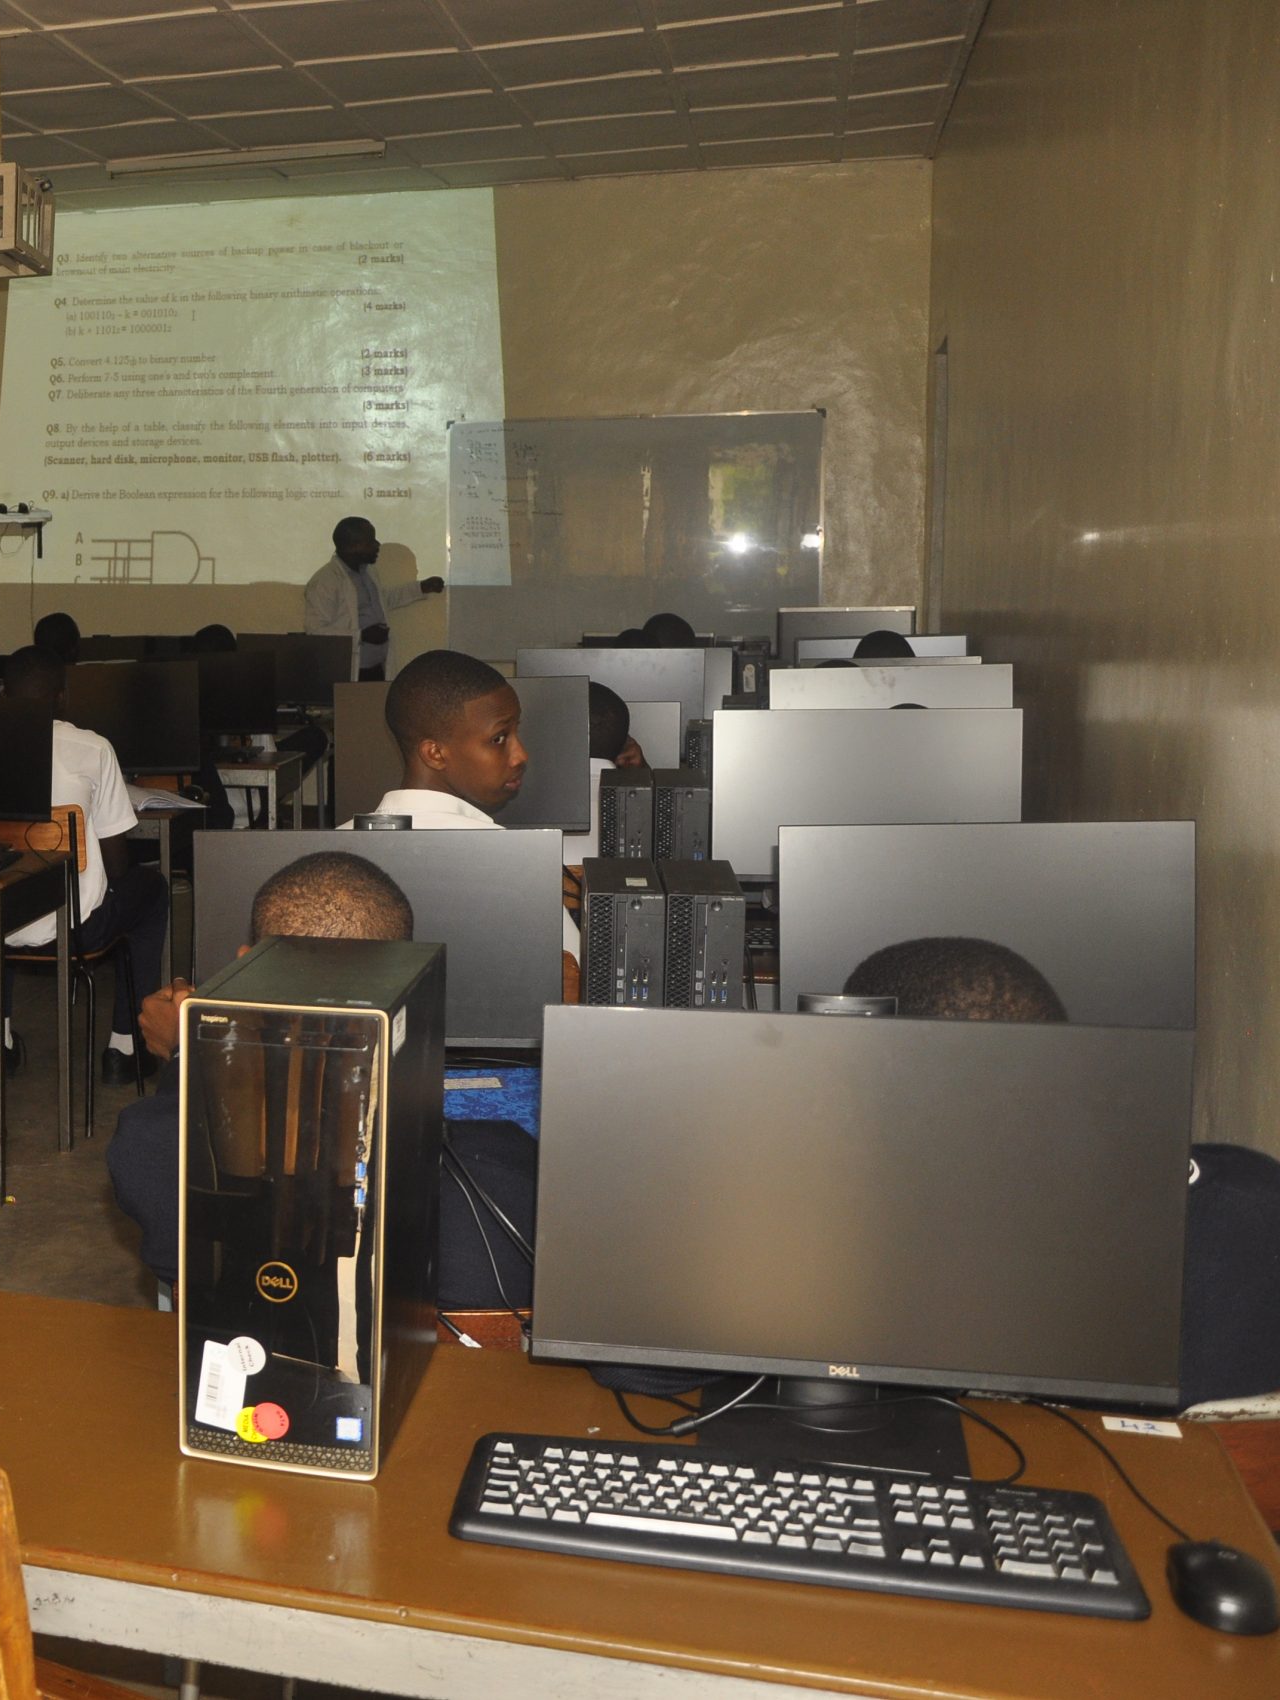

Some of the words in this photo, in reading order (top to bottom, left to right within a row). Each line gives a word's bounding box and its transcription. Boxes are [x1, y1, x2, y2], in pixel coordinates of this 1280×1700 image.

[132, 250, 177, 261] alternative
[181, 248, 215, 258] sources
[218, 246, 229, 256] of
[231, 245, 263, 257] backup
[268, 245, 295, 257] power
[299, 245, 308, 254] in
[312, 244, 333, 253] case
[336, 241, 345, 252] of
[349, 240, 389, 251] blackout
[393, 242, 405, 250] or
[99, 264, 108, 275] of
[72, 296, 118, 307] Determine
[119, 294, 134, 304] the
[161, 292, 170, 303] of
[171, 292, 179, 303] k
[180, 293, 189, 303] in
[191, 290, 206, 302] the
[207, 288, 248, 302] following
[250, 288, 280, 301] binary
[281, 287, 328, 299] arithmetic
[68, 356, 103, 368] Convert
[138, 354, 148, 365] to
[150, 354, 178, 366] binary
[68, 371, 102, 384] Perform
[122, 371, 146, 384] using
[173, 369, 191, 381] and
[67, 387, 112, 400] Deliberate
[114, 390, 131, 400] any
[132, 387, 156, 399] three
[157, 384, 225, 398] characteristics
[226, 384, 237, 395] of
[238, 383, 253, 395] the
[255, 383, 288, 395] Fourth
[290, 383, 340, 397] generation
[342, 383, 352, 393] of
[66, 423, 78, 436] By
[81, 421, 97, 433] the
[100, 420, 119, 435] help
[122, 420, 132, 432] of
[172, 418, 206, 433] classify
[209, 418, 225, 431] the
[227, 418, 271, 432] following
[273, 419, 316, 430] elements
[319, 418, 339, 429] into
[341, 418, 368, 432] input
[45, 438, 75, 451] output
[77, 436, 110, 449] devices
[112, 436, 130, 448] and
[132, 436, 165, 450] storage
[91, 453, 112, 465] hard
[140, 451, 201, 467] microphone,
[248, 451, 270, 463] USB
[71, 487, 101, 500] Derive
[103, 487, 118, 499] the
[120, 486, 157, 500] Boolean
[158, 487, 207, 503] expression
[209, 486, 223, 499] for
[224, 486, 240, 498] the
[241, 486, 284, 501] following
[286, 486, 308, 501] logic
[75, 530, 84, 544] A
[200, 1014, 229, 1023] Inspiron
[261, 1275, 293, 1289] DELL
[828, 1365, 860, 1377] DELL
